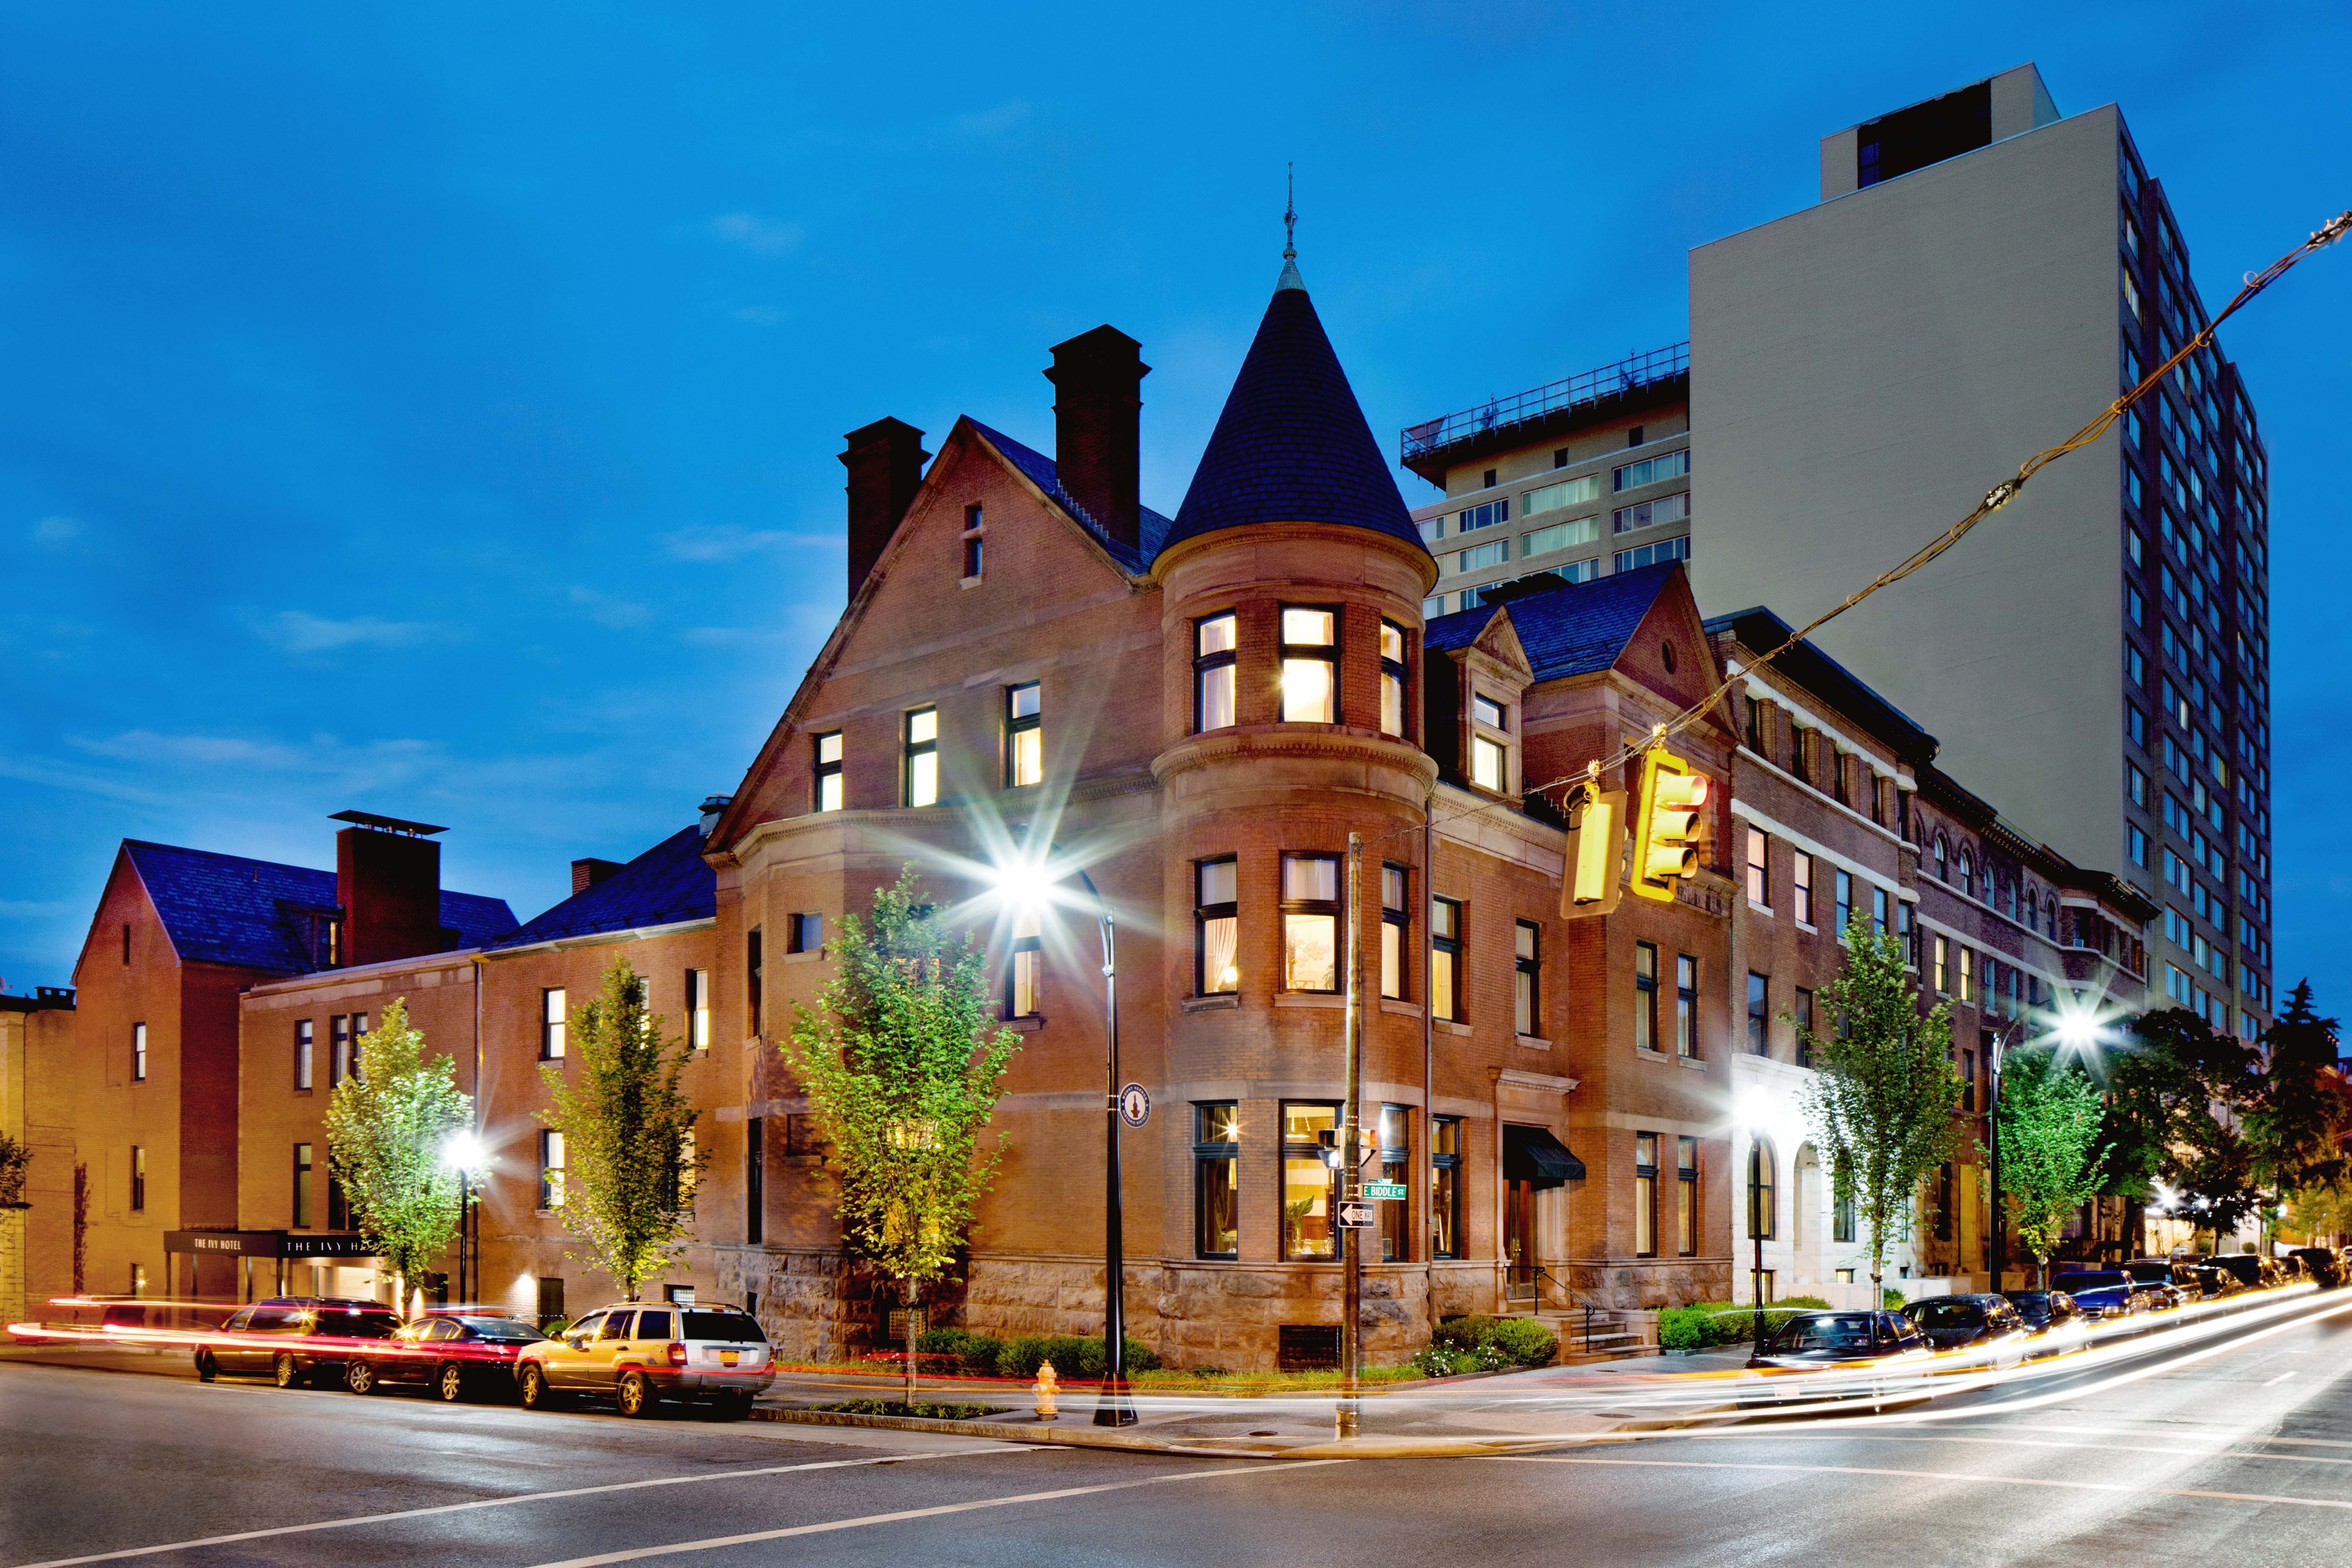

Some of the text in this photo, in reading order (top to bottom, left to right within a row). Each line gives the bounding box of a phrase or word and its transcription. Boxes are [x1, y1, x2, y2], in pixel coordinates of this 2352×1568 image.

[1122, 1086, 1147, 1100] MOUNT VERNON
[1122, 1110, 1148, 1125] HISTORIC DISTRICT
[1364, 1186, 1369, 1196] E.
[1371, 1186, 1397, 1197] BIDDLE
[1352, 1210, 1372, 1220] ONE WAY
[195, 1239, 241, 1250] THE IVY HOTEL
[287, 1242, 341, 1251] THE IVY
